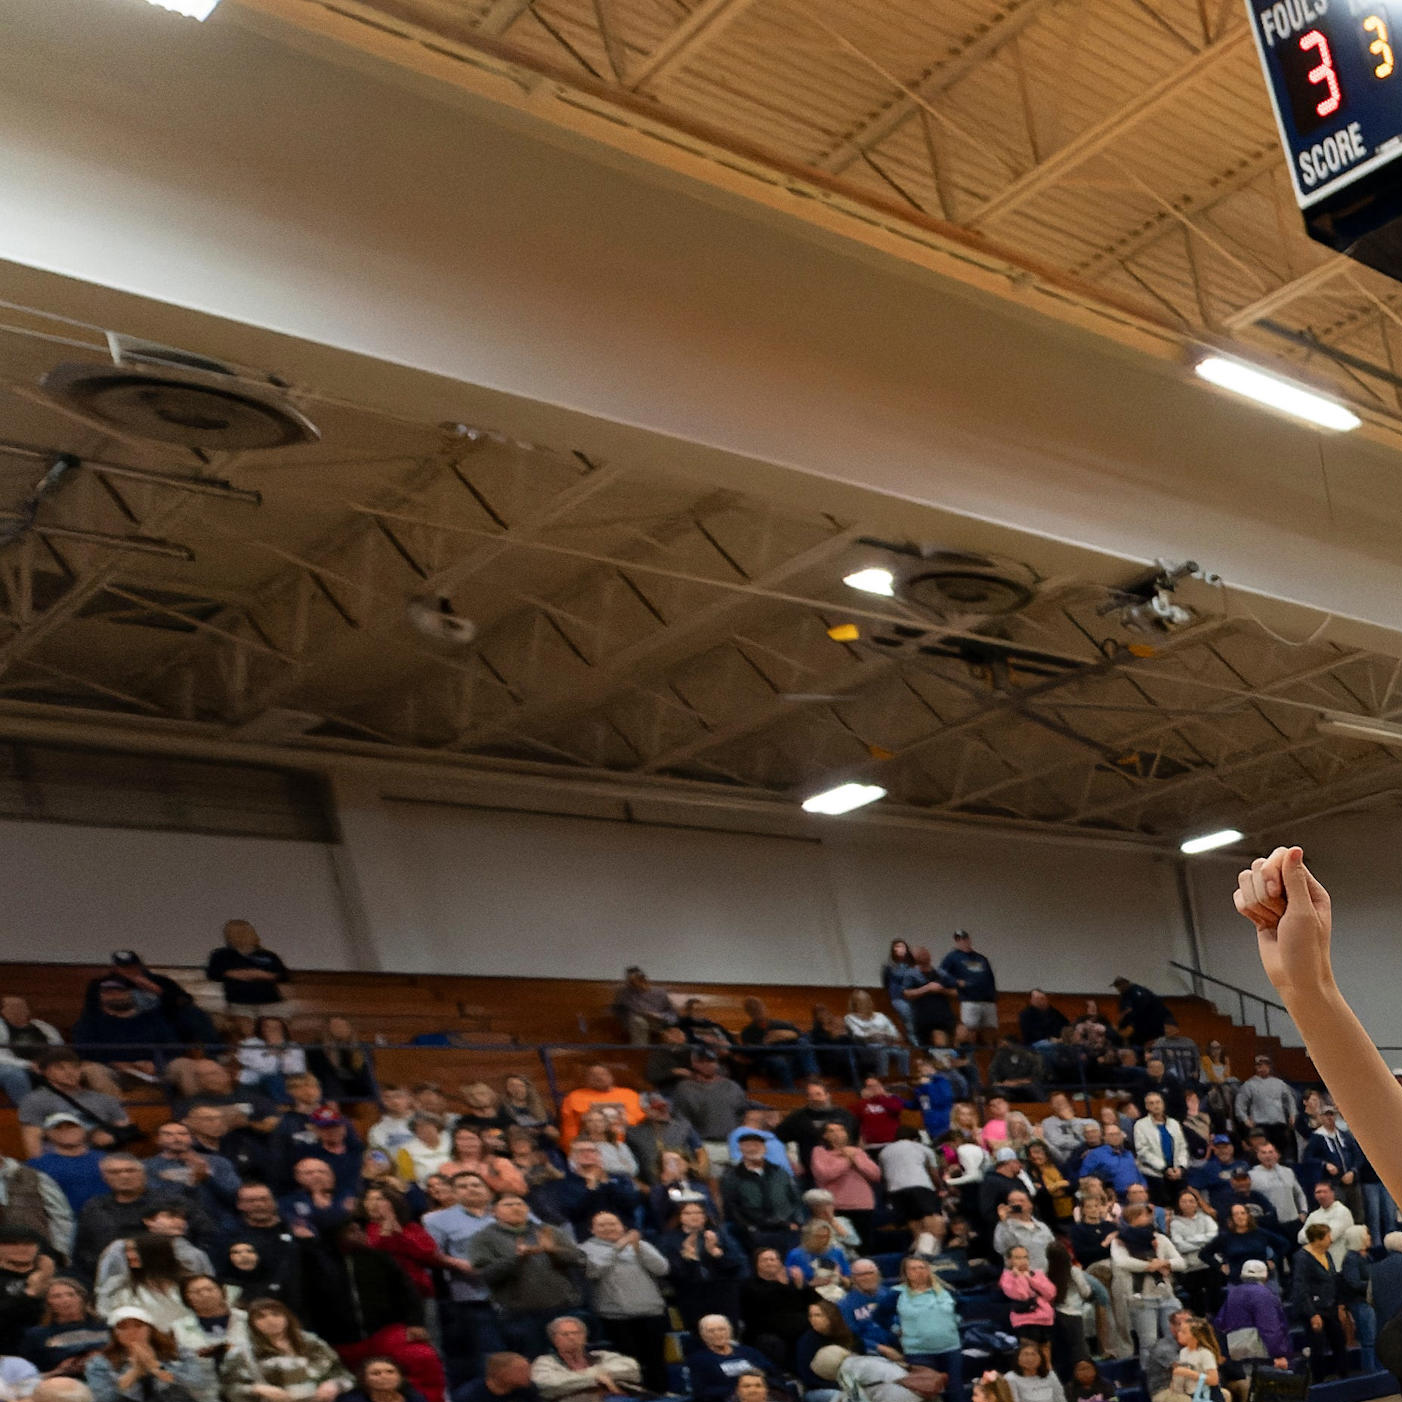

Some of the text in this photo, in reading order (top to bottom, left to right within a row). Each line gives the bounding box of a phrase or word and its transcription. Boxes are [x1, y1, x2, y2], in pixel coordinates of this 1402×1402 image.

[1299, 29, 1341, 117] 3
[1363, 14, 1394, 79] 3
[1299, 121, 1367, 187] SCORE
